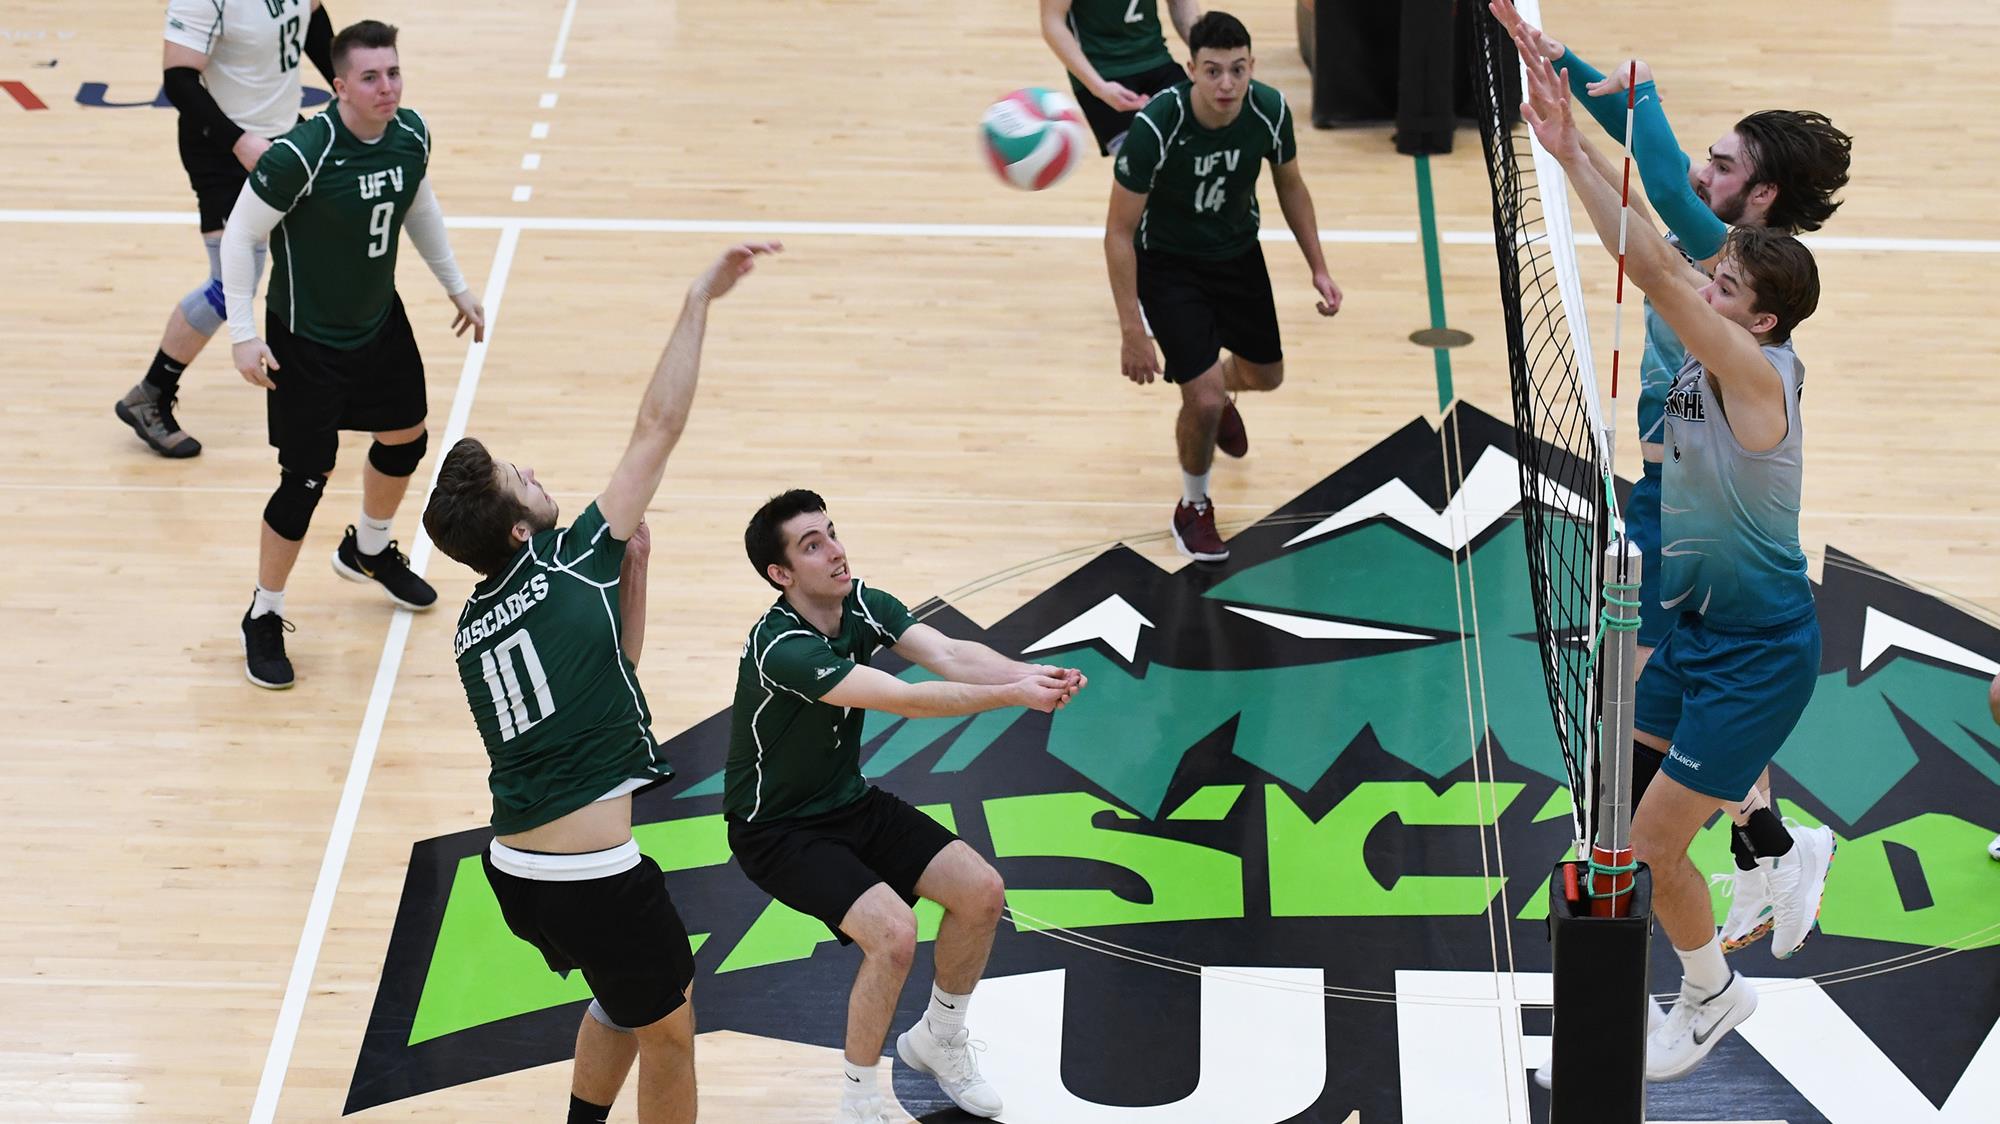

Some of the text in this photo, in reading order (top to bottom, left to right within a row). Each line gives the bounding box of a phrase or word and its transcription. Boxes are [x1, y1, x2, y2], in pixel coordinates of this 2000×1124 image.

[280, 15, 302, 73] 13
[357, 165, 404, 200] UFV
[1194, 149, 1241, 177] UFV
[1194, 176, 1226, 213] 14
[368, 201, 395, 259] 9
[455, 572, 549, 659] CASCADES
[480, 628, 556, 743] 10
